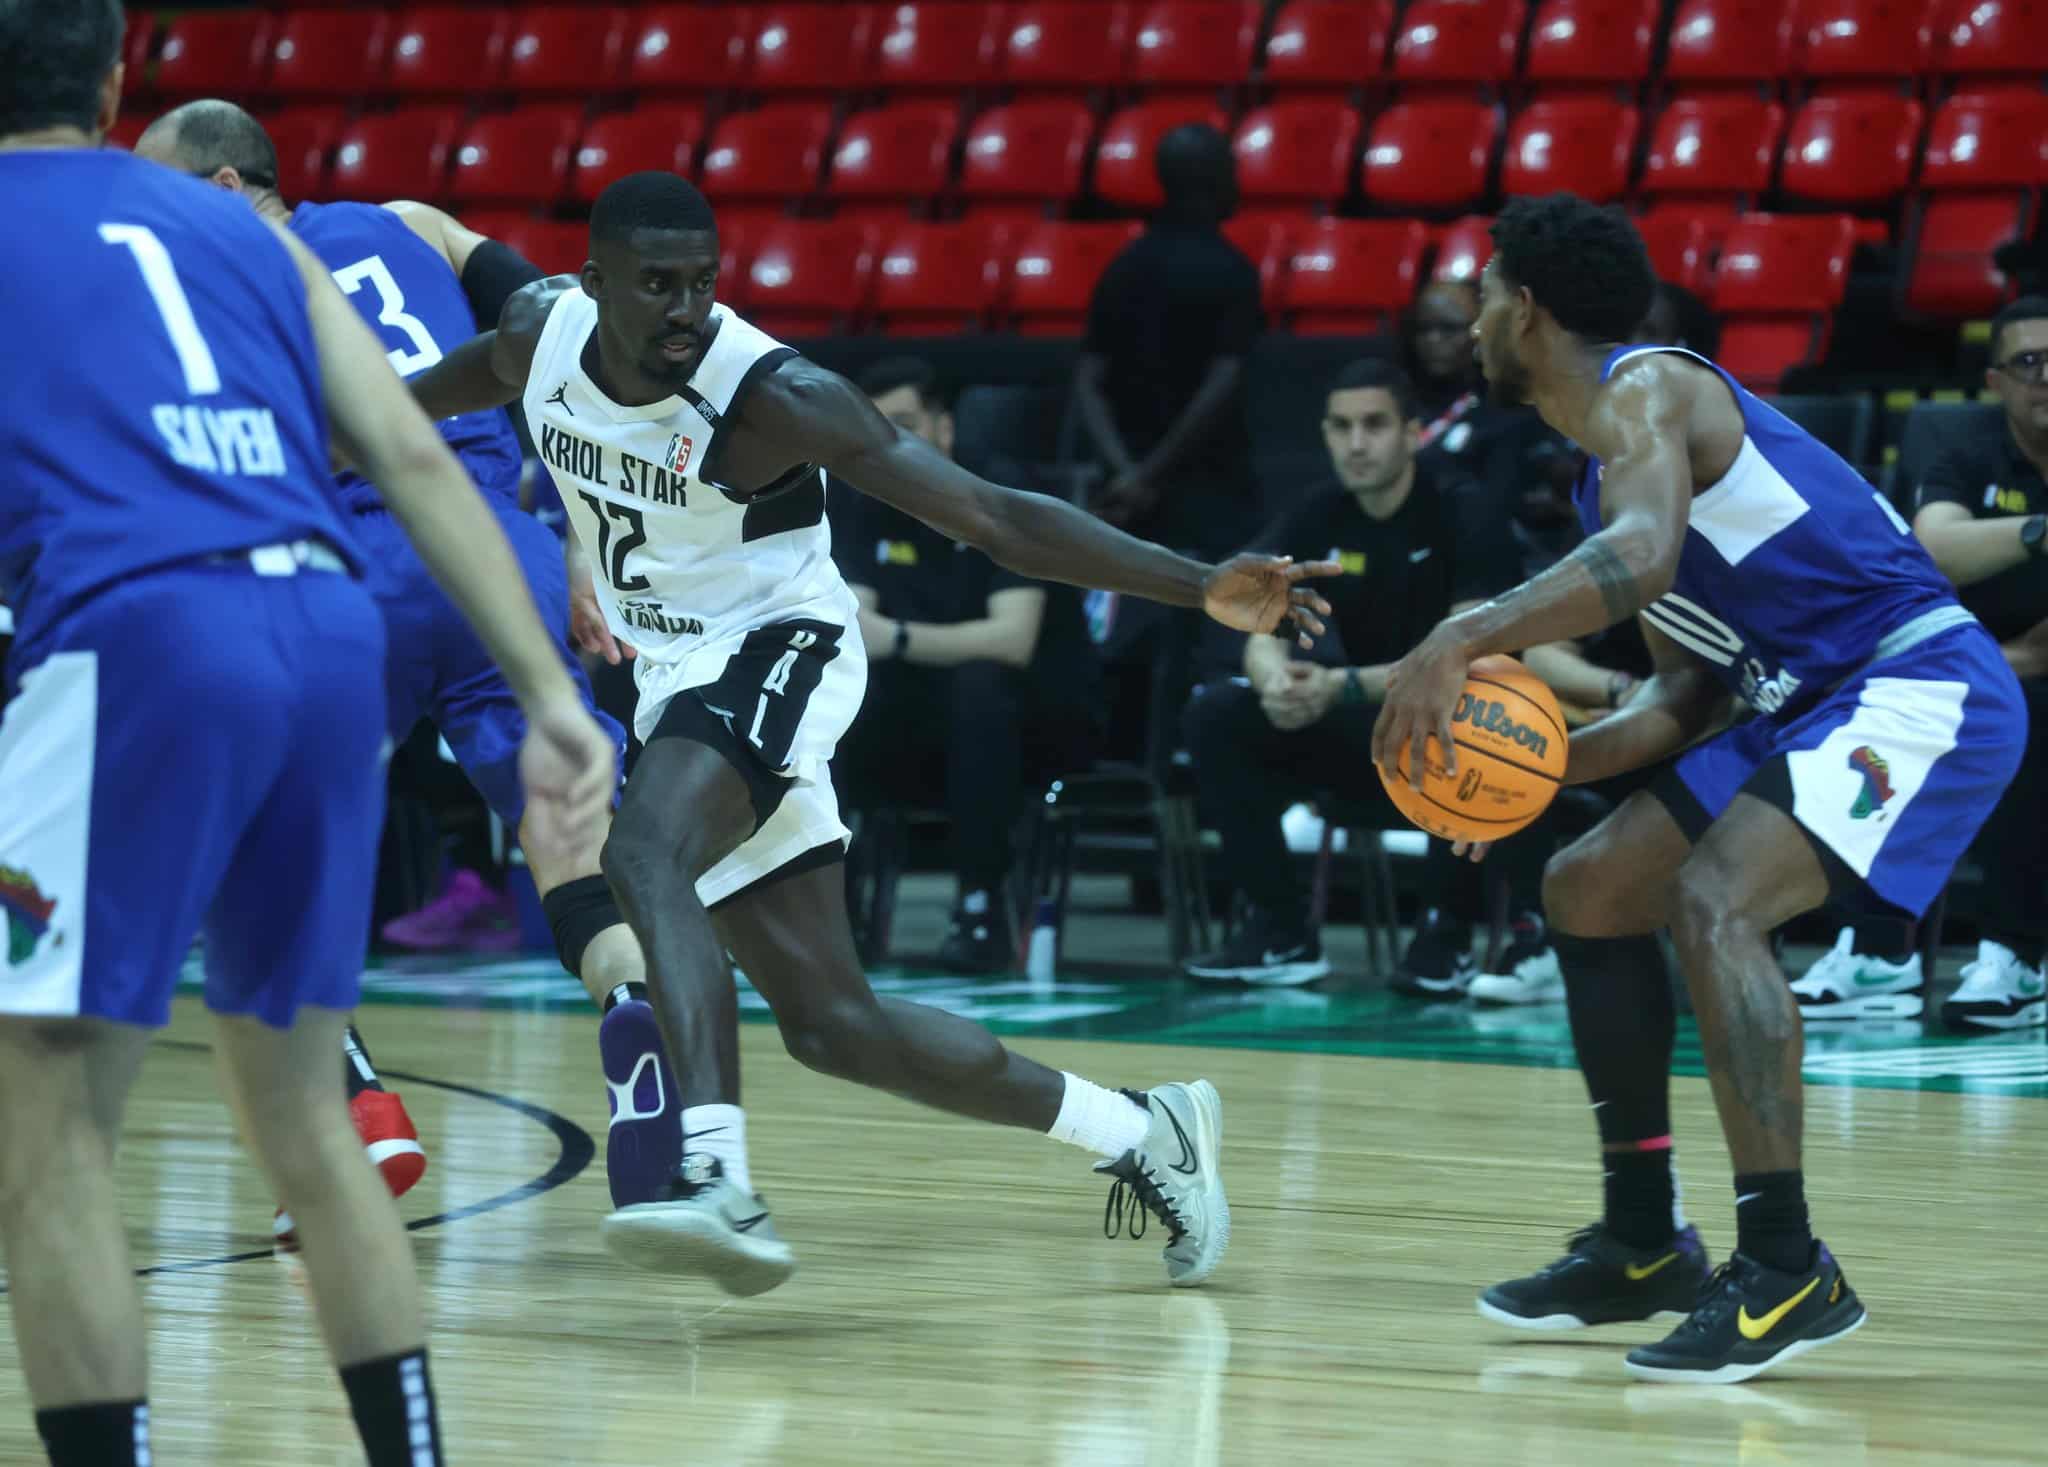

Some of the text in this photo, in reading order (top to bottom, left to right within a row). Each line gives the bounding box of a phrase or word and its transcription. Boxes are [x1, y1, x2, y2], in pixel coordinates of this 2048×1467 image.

[98, 222, 221, 396] 1
[541, 423, 688, 508] KRIOL STAR
[577, 488, 652, 592] 12
